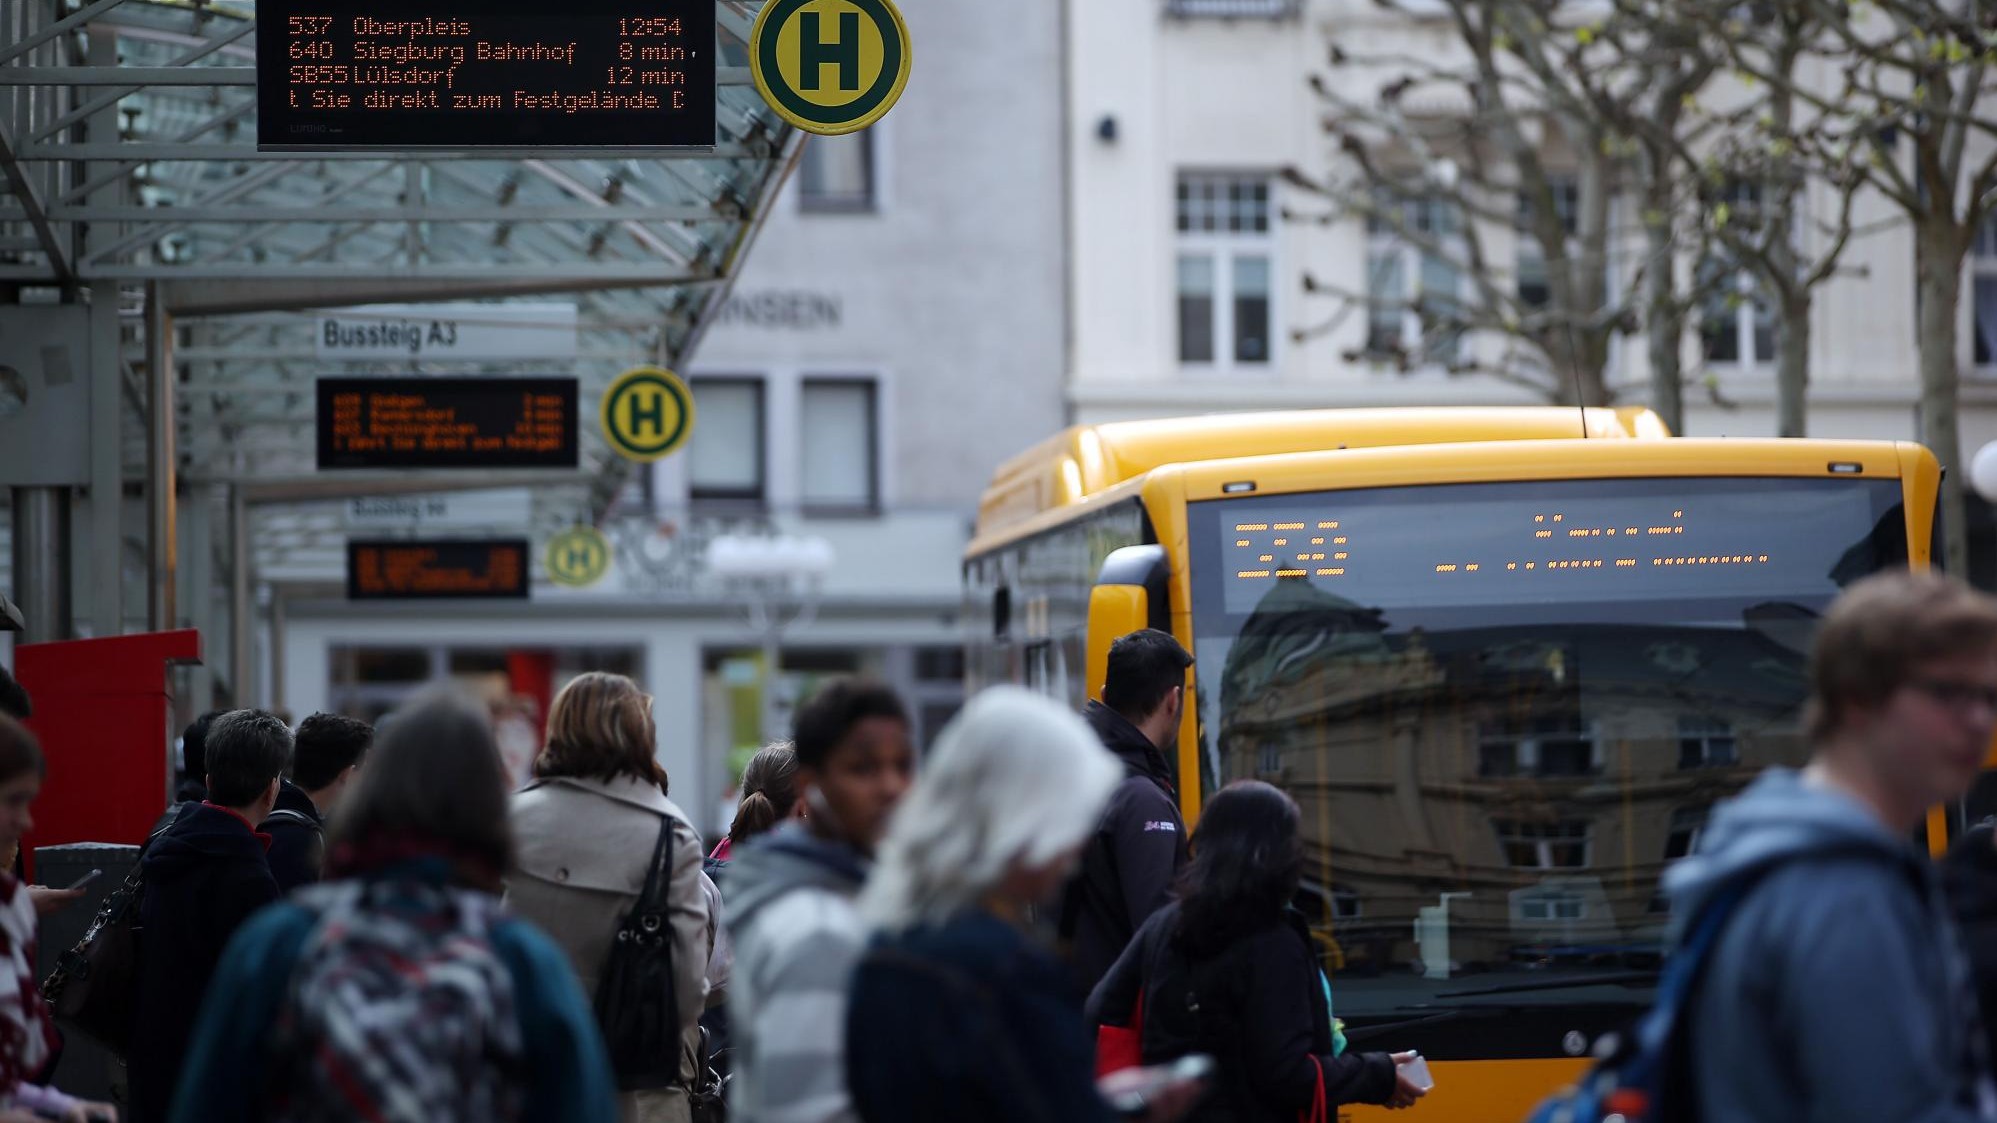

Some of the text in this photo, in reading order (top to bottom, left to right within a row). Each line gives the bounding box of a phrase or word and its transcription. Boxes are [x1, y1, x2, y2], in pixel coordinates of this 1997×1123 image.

[289, 16, 682, 39] 537 Oberpleis 12:54
[289, 40, 684, 65] 640 Siegburg Bahnhof 8 min
[799, 12, 859, 90] H
[289, 65, 684, 89] SB55 Lülsdorf 12 min
[312, 89, 351, 108] Sie
[364, 90, 440, 108] direkt
[453, 95, 501, 108] zum
[323, 317, 457, 354] Bussteig A3
[629, 393, 664, 436] H
